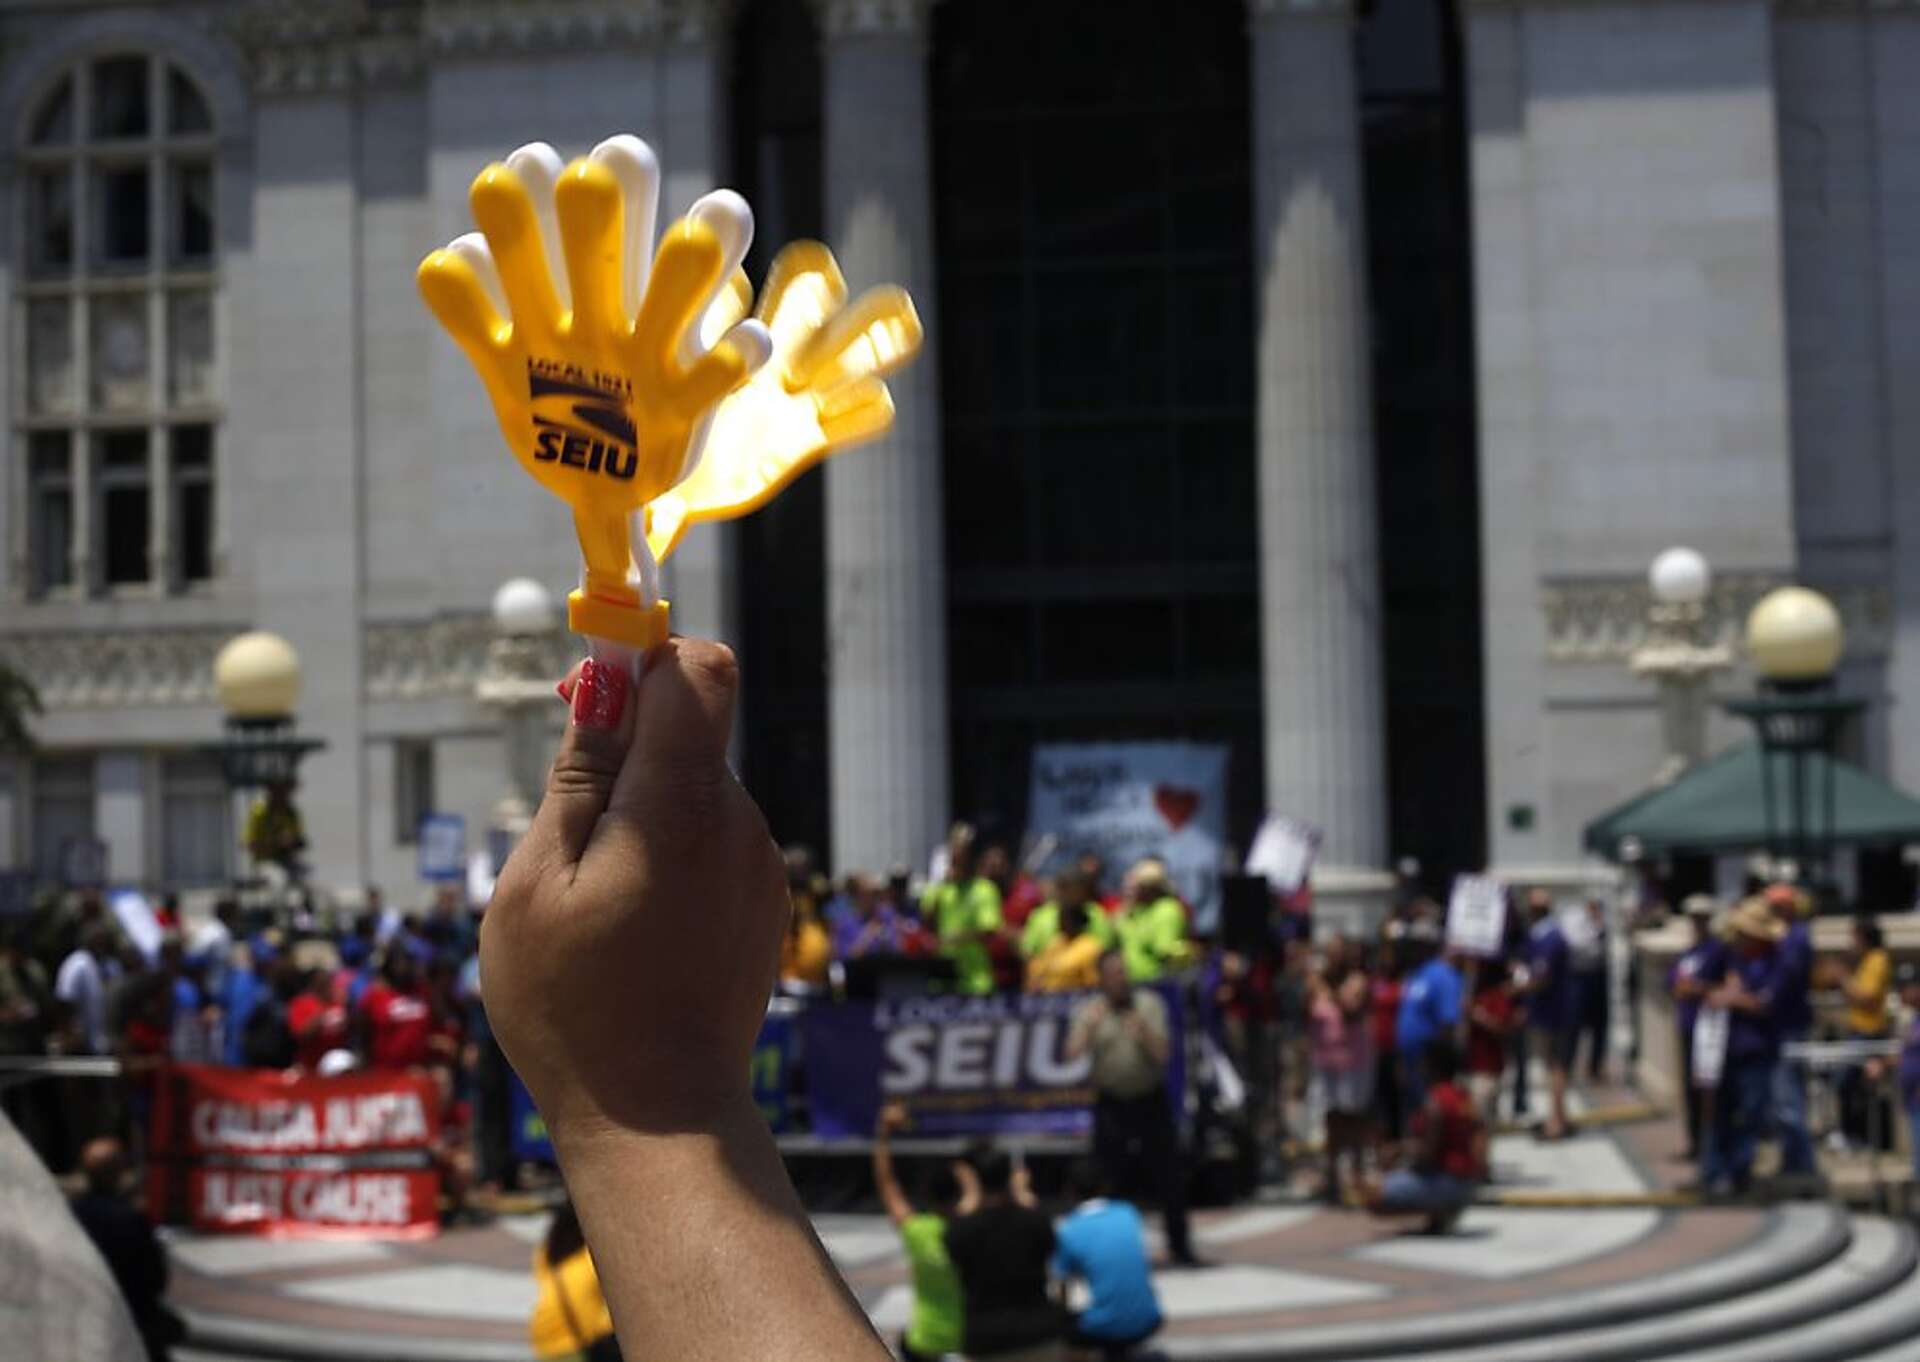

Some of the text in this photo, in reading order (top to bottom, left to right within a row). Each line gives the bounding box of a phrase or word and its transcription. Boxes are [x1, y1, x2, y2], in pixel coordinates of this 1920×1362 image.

[527, 356, 588, 383] LOCAL
[533, 431, 638, 480] SEIU
[872, 996, 1005, 1027] LOCAL
[880, 1018, 1093, 1095] SEIU
[289, 1172, 412, 1224] CAUSE
